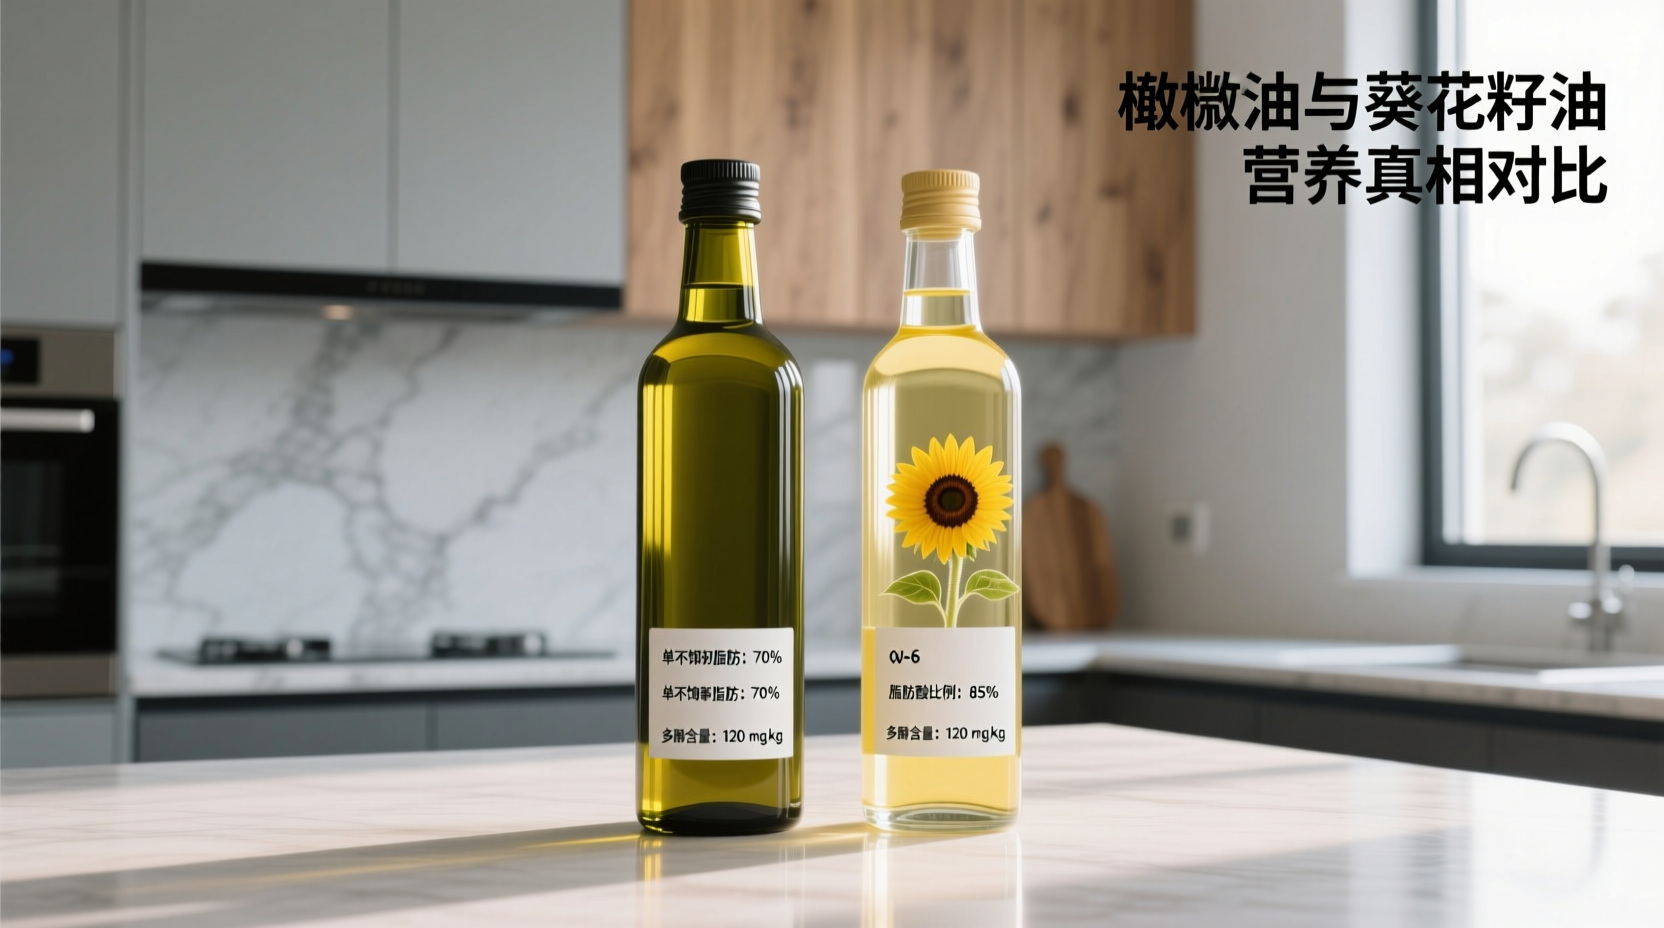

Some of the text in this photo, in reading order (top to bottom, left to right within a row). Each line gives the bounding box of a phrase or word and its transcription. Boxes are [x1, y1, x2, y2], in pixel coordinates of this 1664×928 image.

[752, 649, 783, 664] 70%
[751, 685, 780, 700] 70%
[969, 685, 999, 699] 85%
[723, 729, 746, 743] 120
[945, 726, 968, 740] 120
